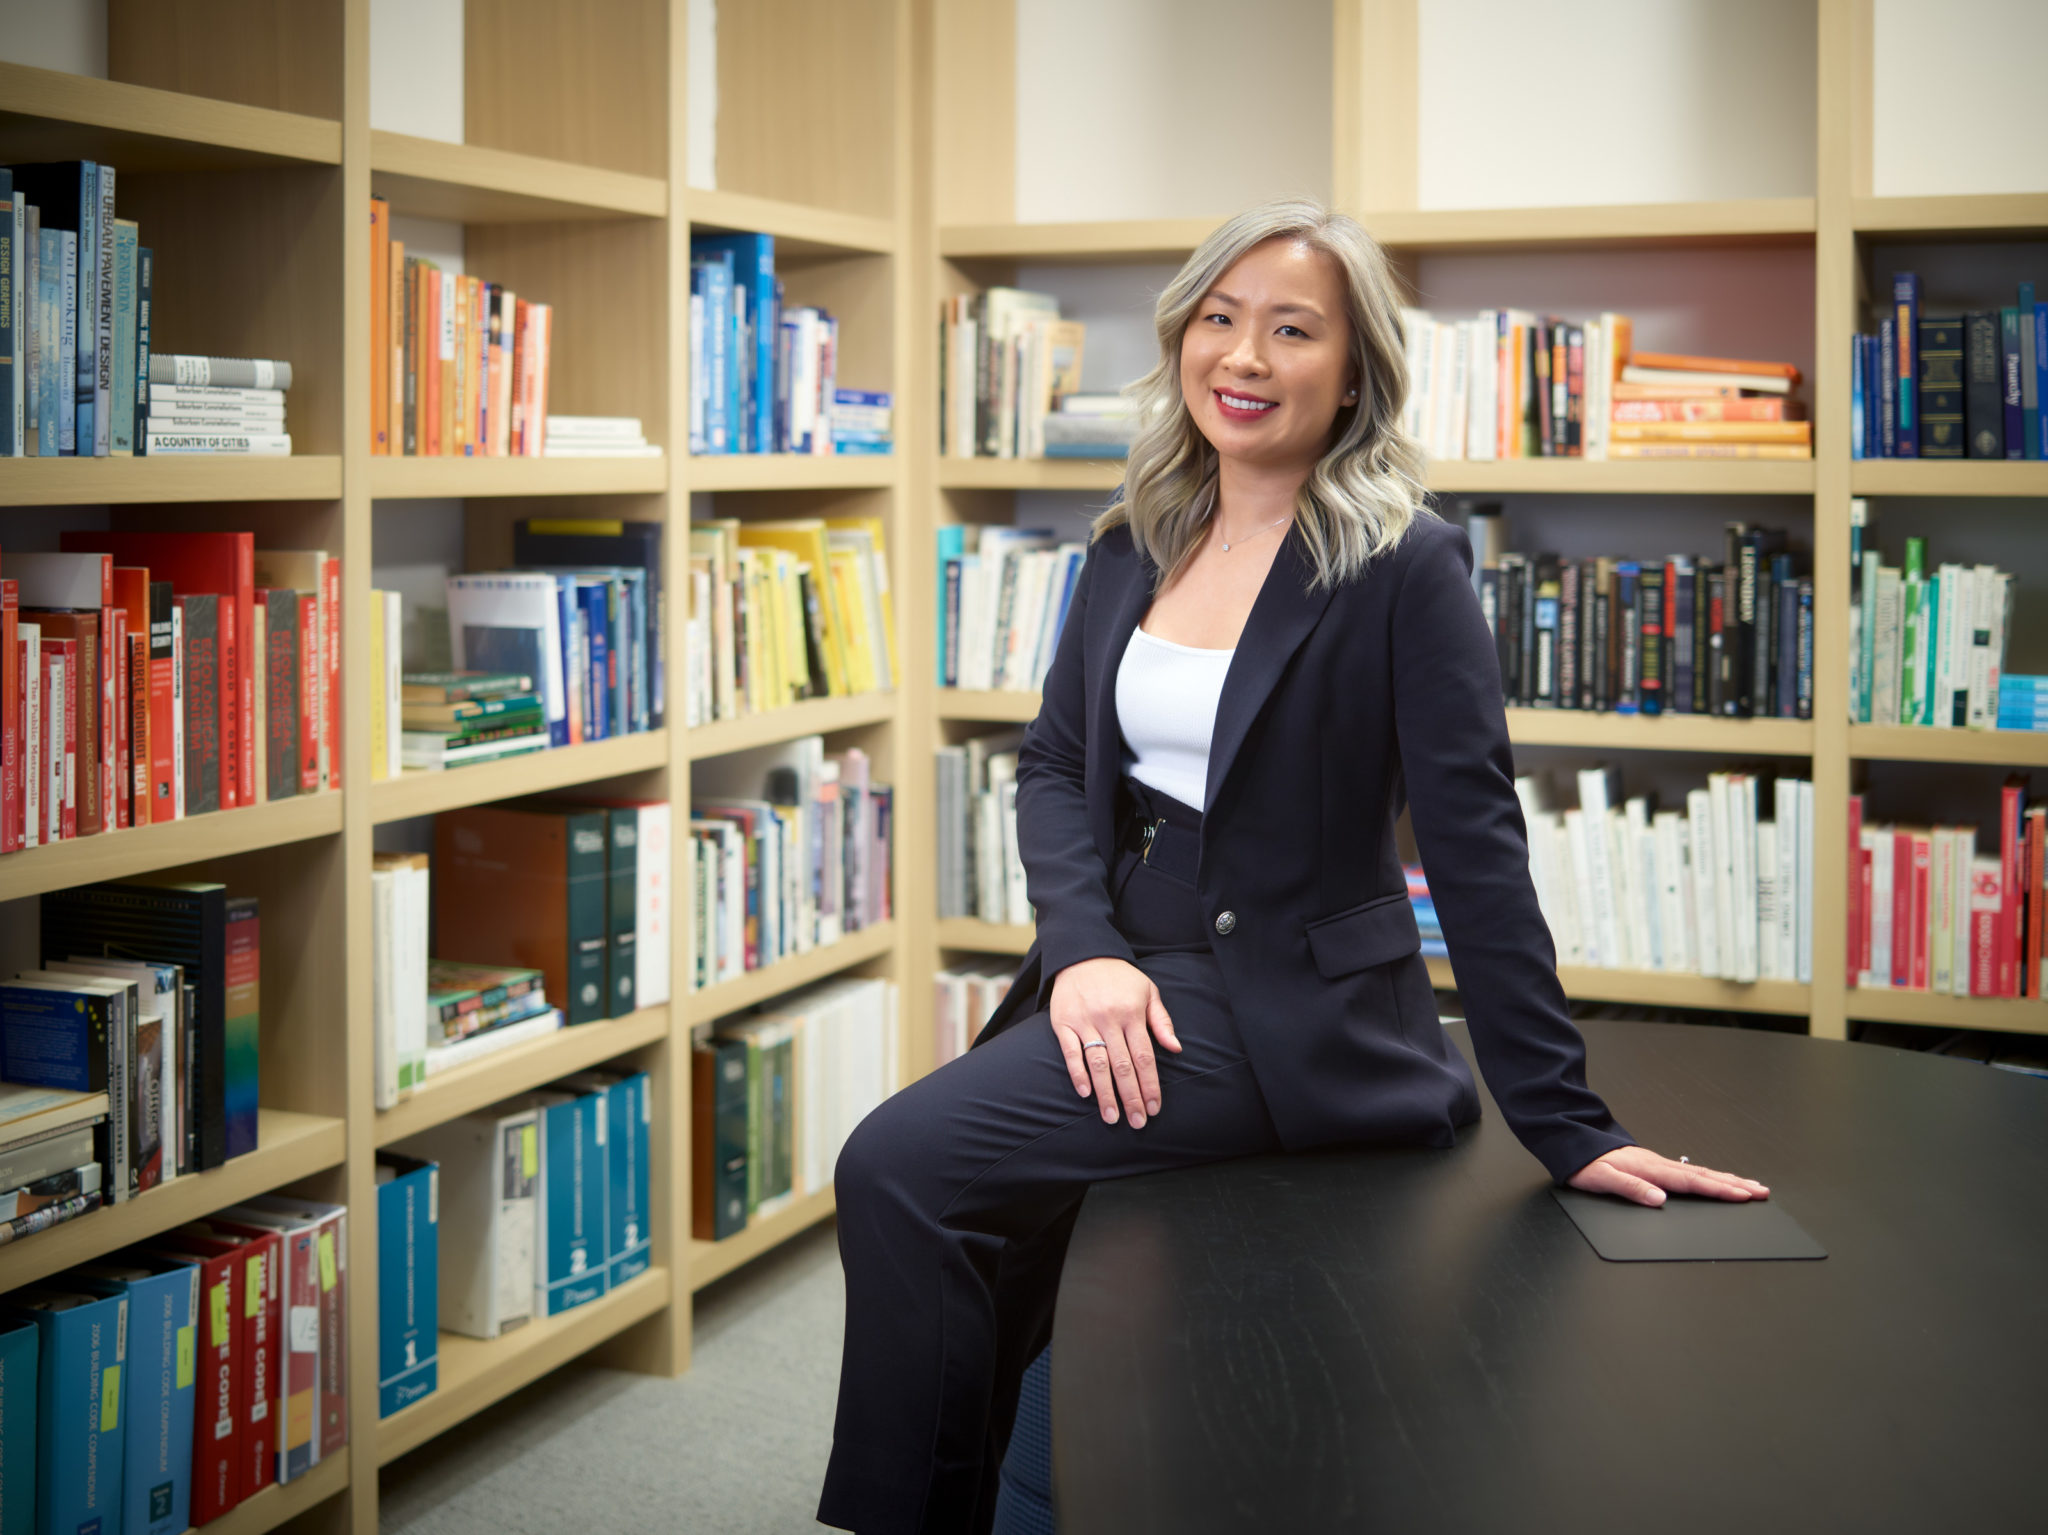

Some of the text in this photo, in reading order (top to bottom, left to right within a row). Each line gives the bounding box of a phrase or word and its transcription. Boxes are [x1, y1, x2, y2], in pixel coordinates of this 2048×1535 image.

[102, 195, 113, 249] URBAN
[0, 236, 10, 329] DESIGN GRAPHICS
[29, 257, 40, 325] Designing
[60, 240, 76, 346] On Looking
[100, 251, 112, 331] PAVEMENT
[99, 335, 110, 391] DESIGN
[137, 300, 149, 405] MAKING THE INVISIBLE VISIBLE
[175, 384, 202, 394] Suburban
[175, 400, 203, 410] Suburban
[154, 437, 250, 448] A COUNTRY OF CITIES
[173, 417, 200, 426] Suburban
[85, 687, 93, 729] DESIGN
[189, 639, 201, 751] URBANISM
[200, 638, 213, 765] ECOLOGICAL
[228, 701, 235, 721] TO
[271, 631, 281, 739] URBANISM
[281, 630, 292, 753] ECOLOGICAL
[4, 727, 15, 766] Guide
[134, 642, 147, 796] GEORGE MONBIOT HEAT
[30, 744, 38, 807] Metropolis
[86, 741, 95, 817] DECORATION
[227, 730, 235, 783] GREAT
[4, 770, 15, 801] Style
[570, 1247, 587, 1275] 2
[624, 1223, 639, 1249] 2
[162, 1319, 173, 1369] BUILDING
[404, 1339, 418, 1367] 1
[161, 1370, 171, 1398] CODE
[218, 1363, 230, 1421] CODE
[254, 1347, 266, 1403] CODE
[87, 1321, 101, 1509] 2006 BUILDING CODE COMPENDIUM
[159, 1400, 170, 1473] COMPENDIUM
